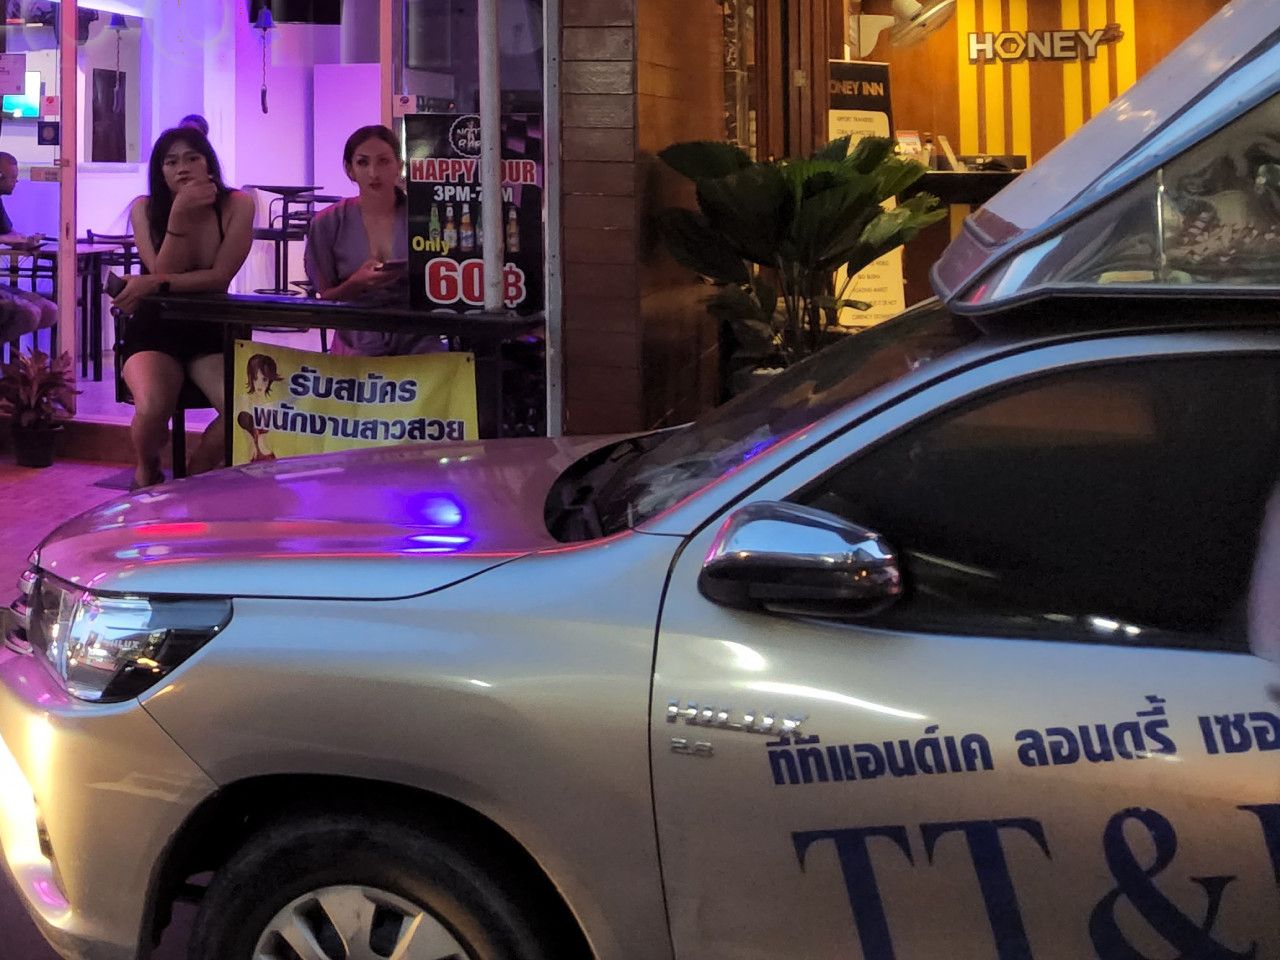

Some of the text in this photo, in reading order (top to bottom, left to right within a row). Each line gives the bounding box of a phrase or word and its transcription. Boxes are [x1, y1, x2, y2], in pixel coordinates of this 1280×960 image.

[969, 29, 1105, 60] HONEY
[862, 81, 884, 96] INN
[410, 157, 477, 183] HAPPY
[412, 236, 450, 256] Only
[289, 365, 418, 404] รับสมัคร
[253, 402, 466, 442] พนักงานสาวสวย
